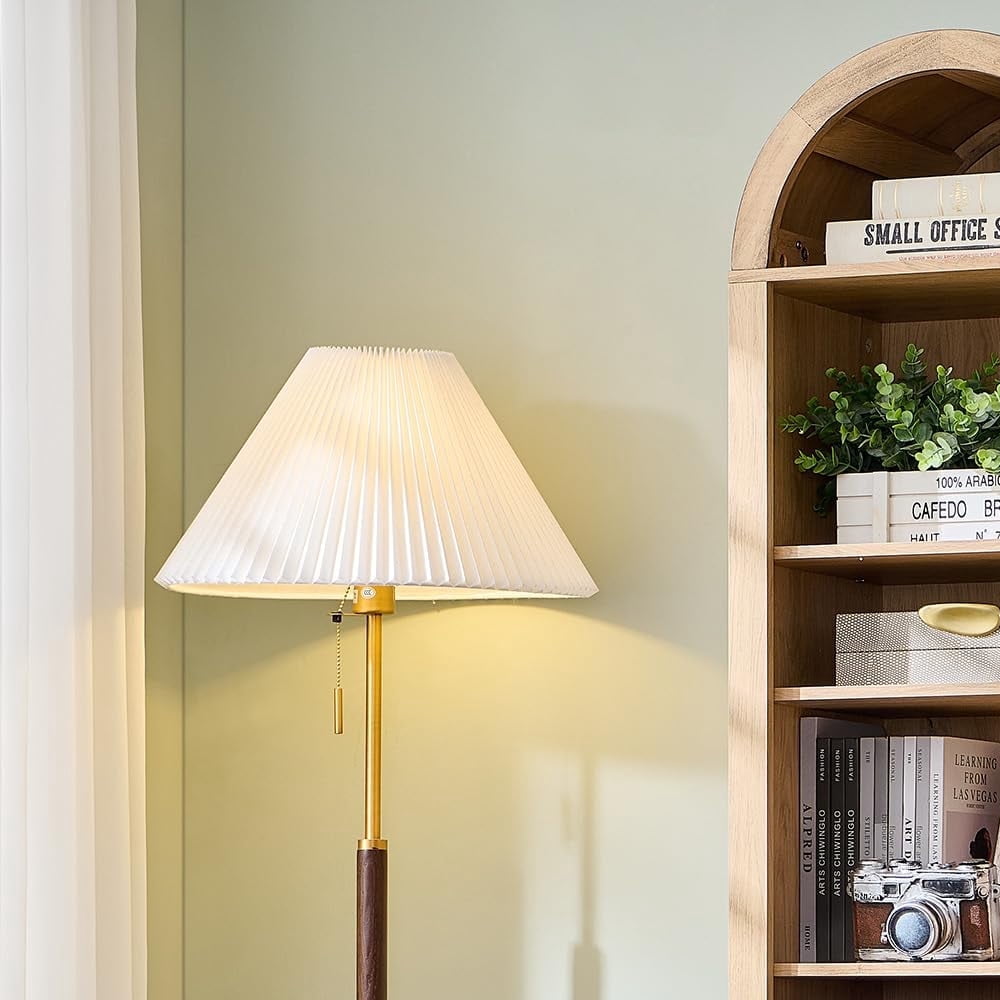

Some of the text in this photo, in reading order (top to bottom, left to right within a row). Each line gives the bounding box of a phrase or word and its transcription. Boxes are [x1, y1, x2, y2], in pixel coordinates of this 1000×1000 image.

[864, 221, 923, 246] SMALL
[930, 218, 987, 242] OFFICE
[936, 476, 963, 489] 100%
[912, 500, 967, 520] CAFEDO
[954, 754, 998, 770] LEARNING
[964, 772, 987, 786] FROM
[802, 804, 812, 873] ALPRED
[833, 810, 841, 896] ARTS CHIWINGLO
